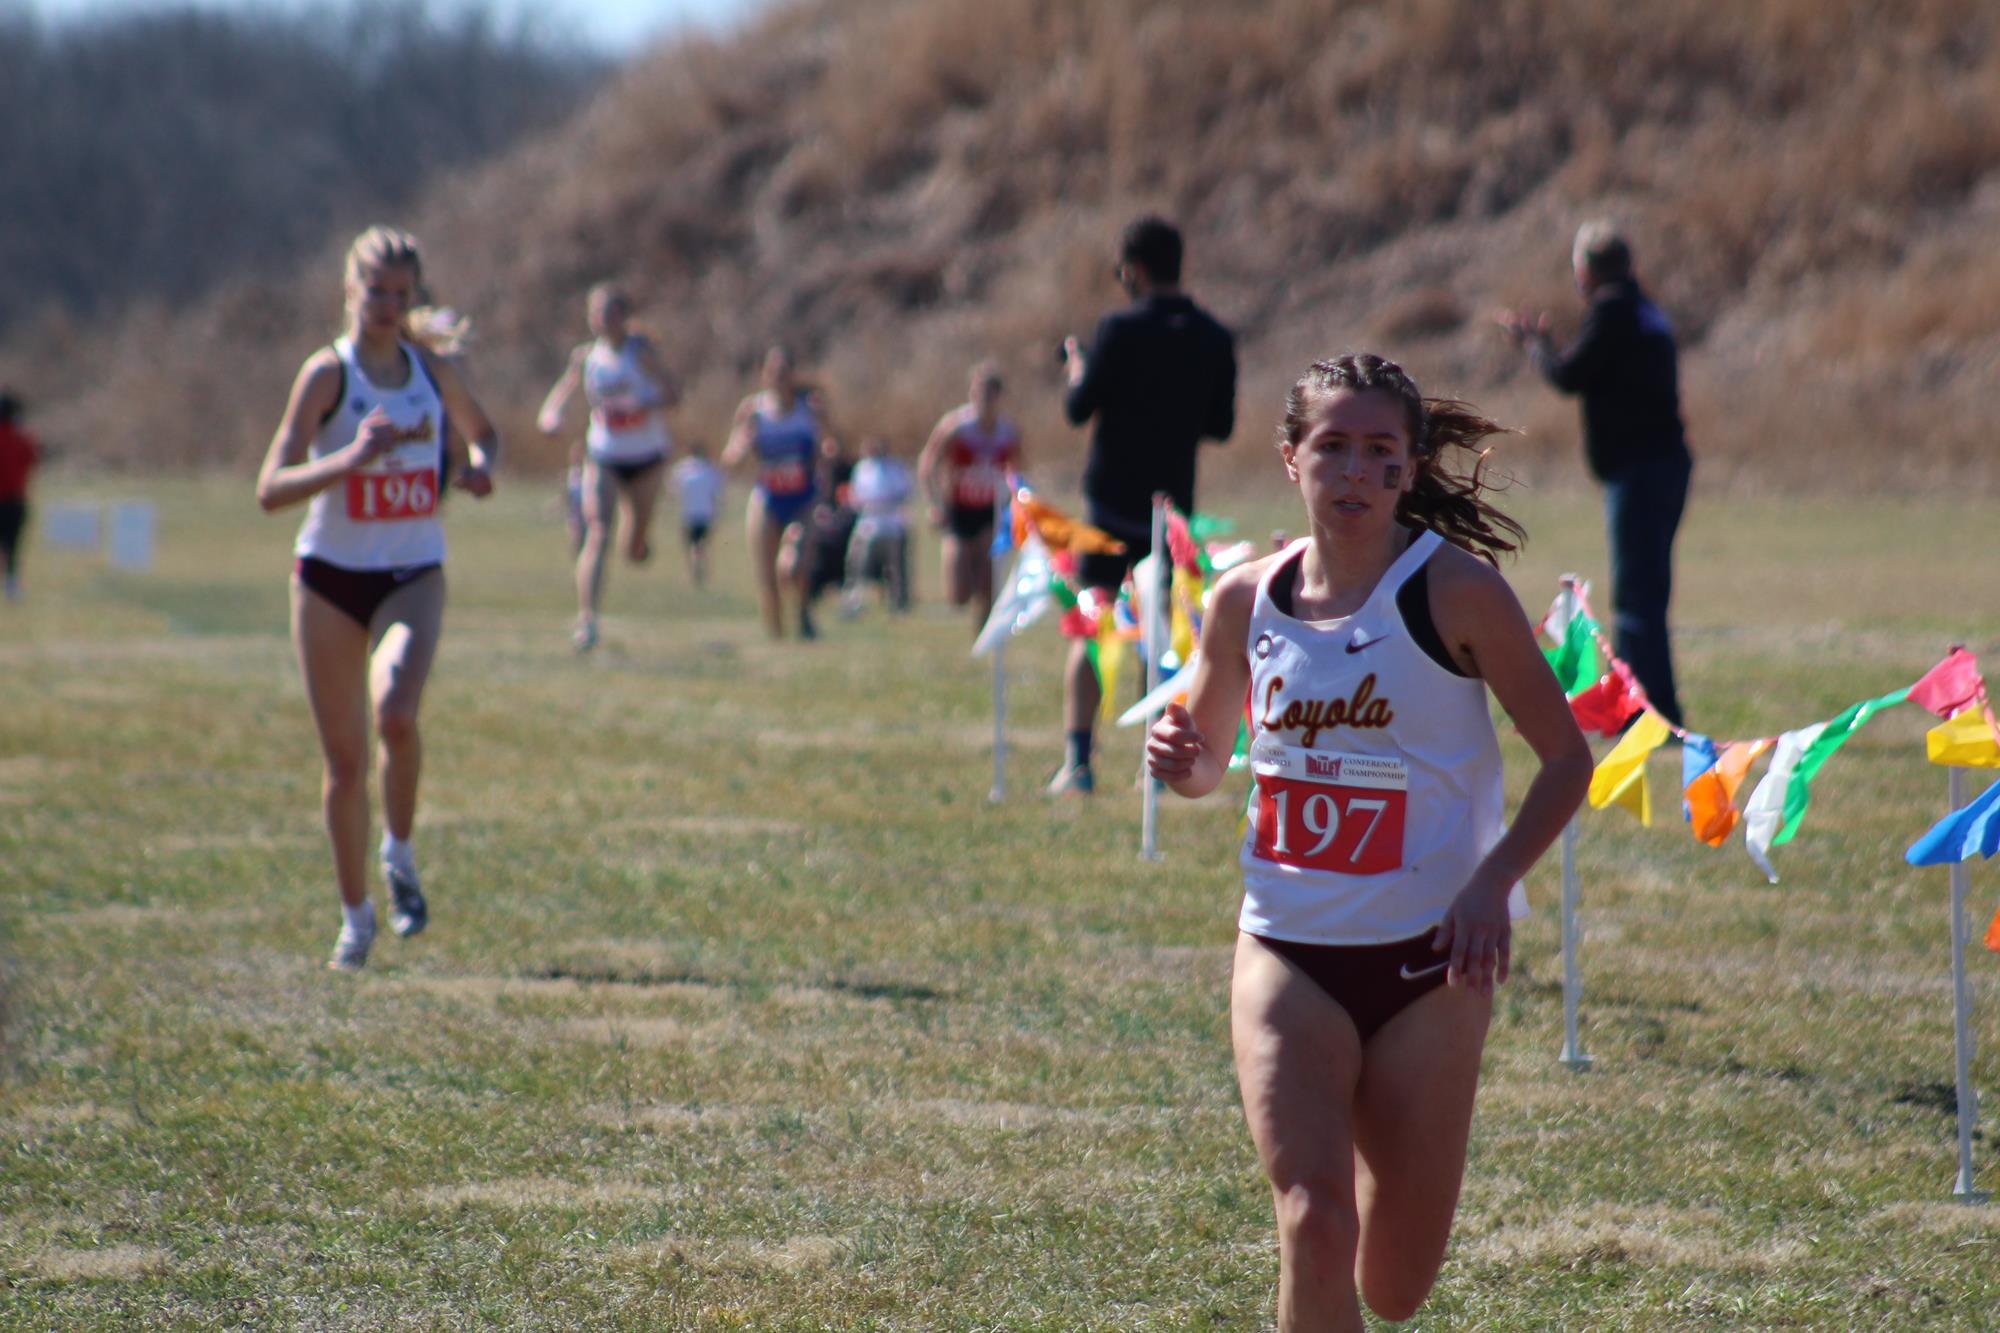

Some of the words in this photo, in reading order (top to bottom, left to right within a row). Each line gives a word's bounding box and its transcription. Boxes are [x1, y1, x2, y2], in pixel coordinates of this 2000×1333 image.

[363, 473, 432, 516] 196
[1261, 672, 1393, 748] Loyola
[1343, 768, 1406, 780] CHAMPIONSHIP
[1344, 759, 1399, 769] CONFERENCE
[1271, 790, 1389, 864] 197
